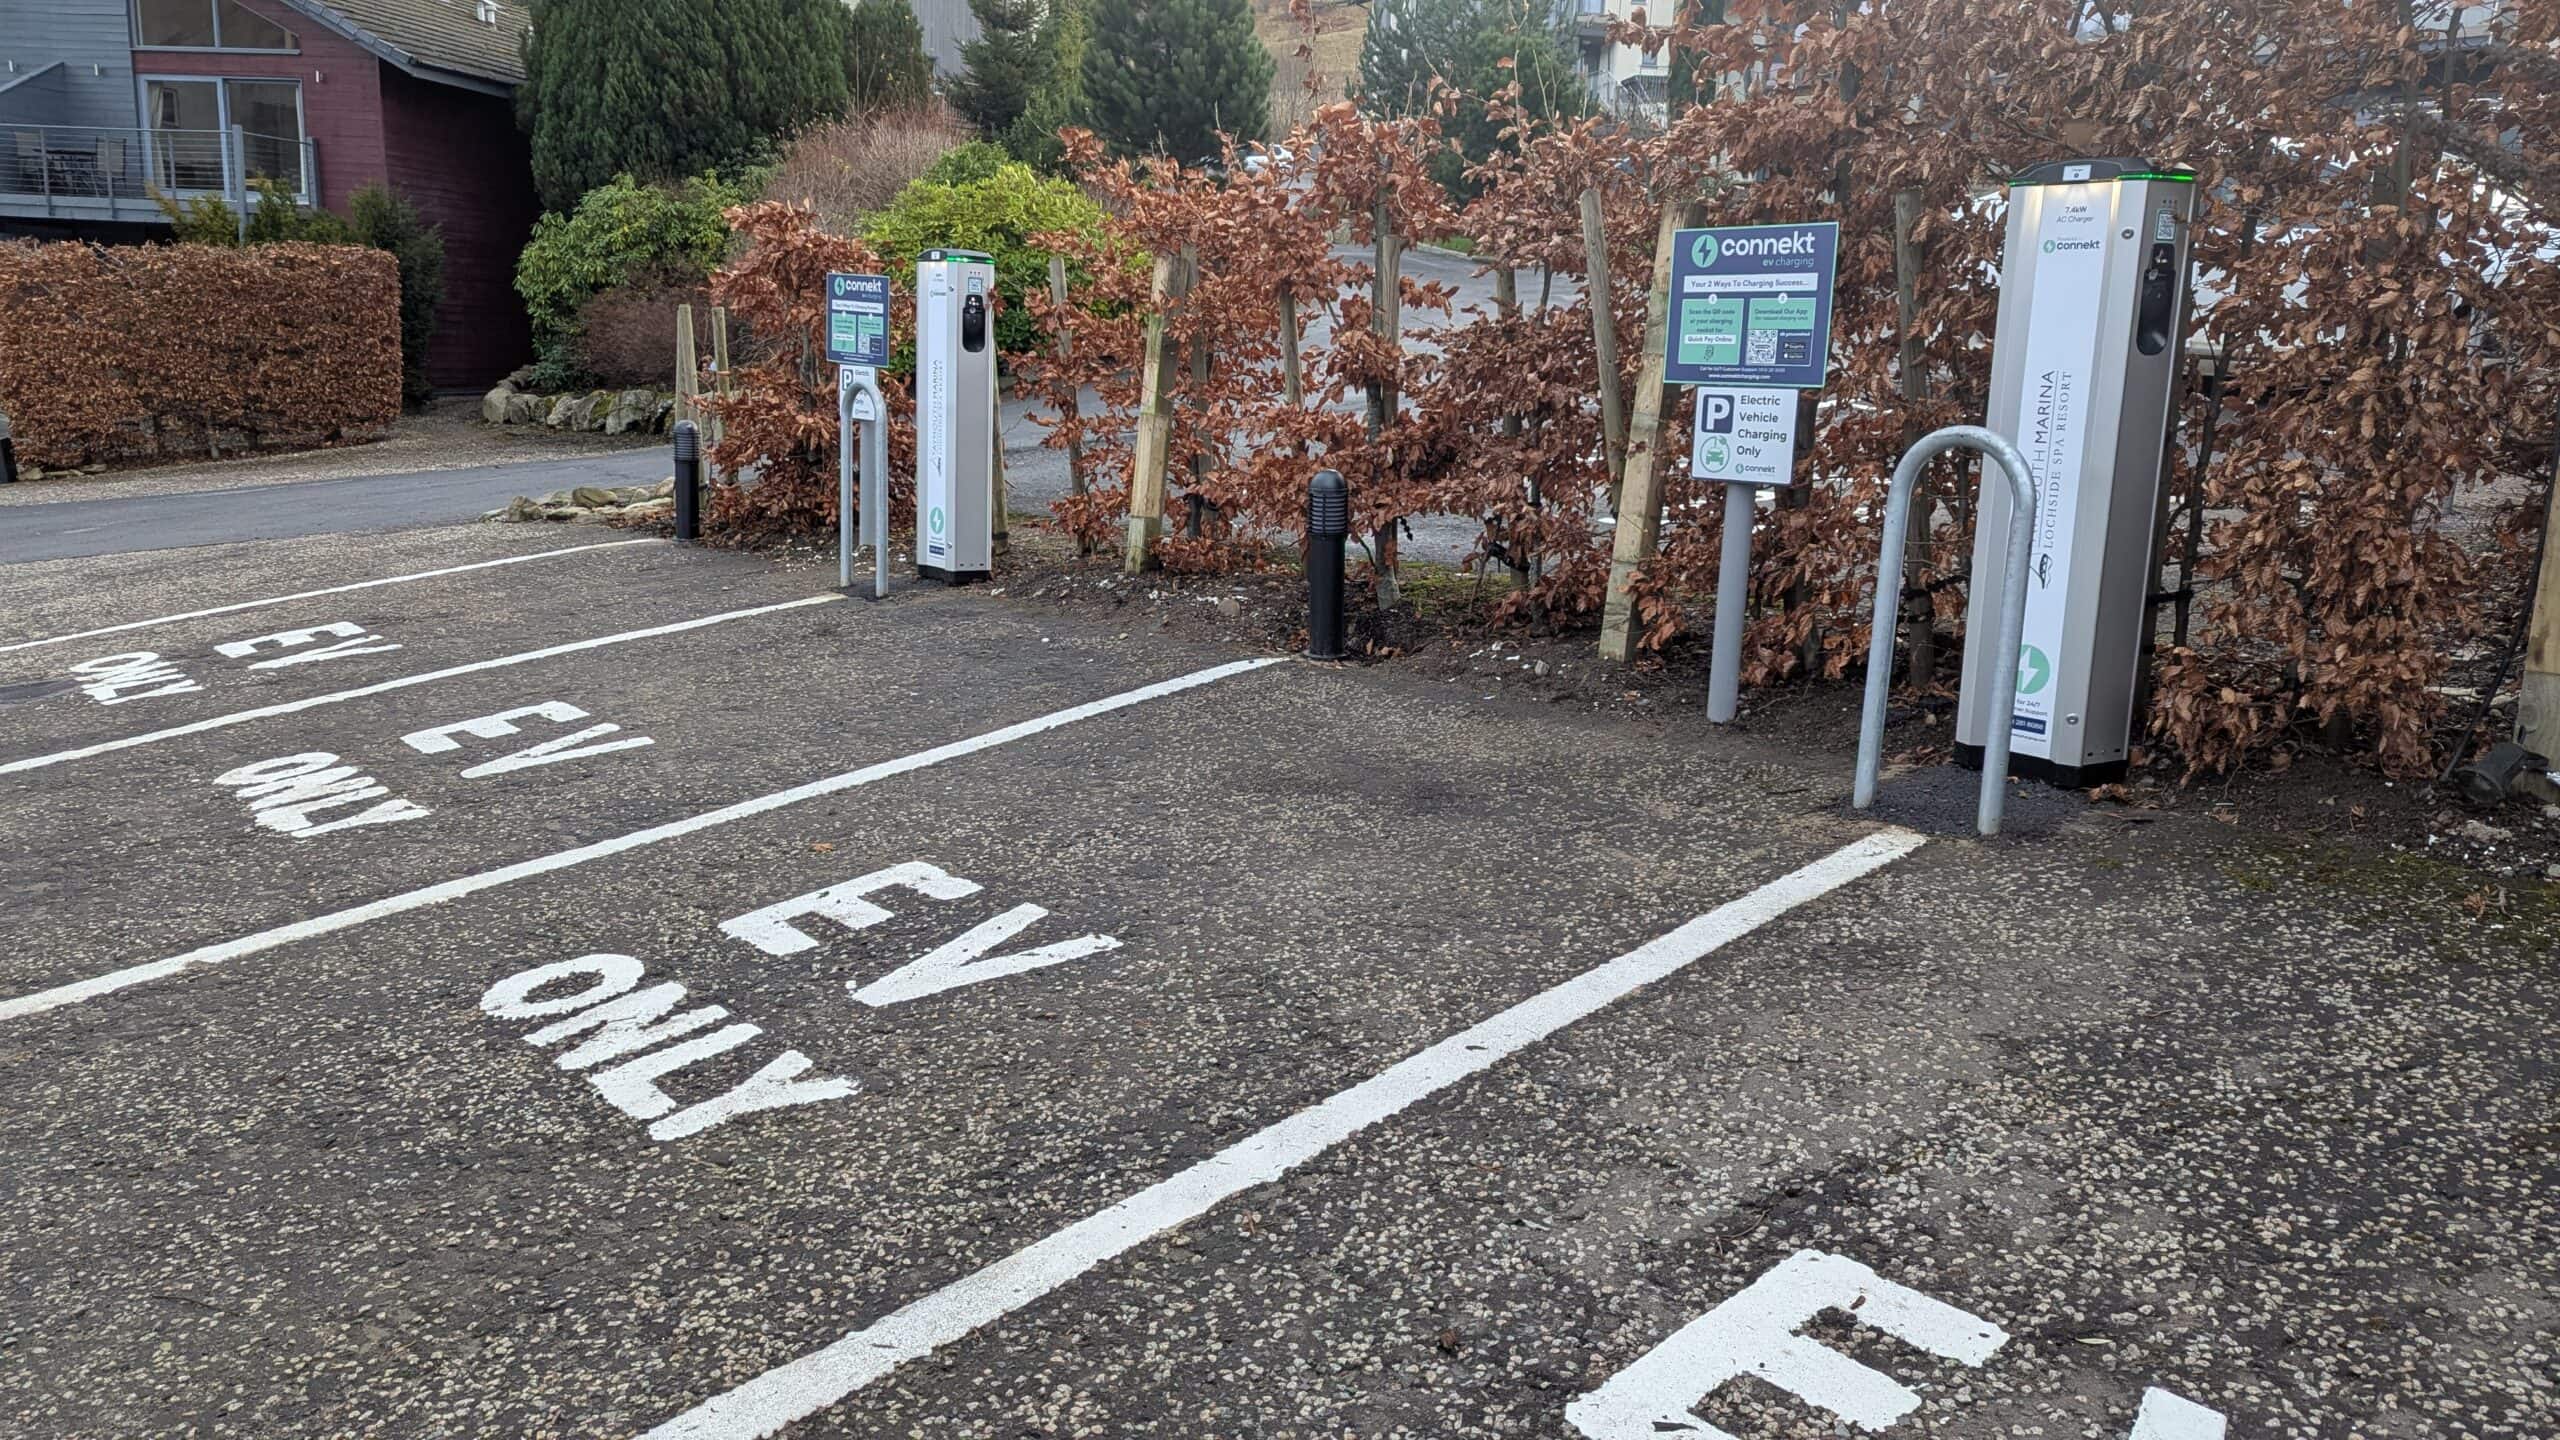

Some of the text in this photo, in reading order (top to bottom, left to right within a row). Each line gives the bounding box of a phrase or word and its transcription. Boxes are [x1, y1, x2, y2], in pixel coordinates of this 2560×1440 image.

[1721, 231, 1816, 256] connekt
[2056, 240, 2100, 250] connekt
[1762, 256, 1814, 268] ev charging
[846, 279, 882, 293] connekt
[1708, 280, 1713, 288] 2
[1713, 280, 1731, 289] Ways
[1742, 279, 1774, 289] Charging
[1796, 308, 1808, 316] App
[843, 370, 853, 390] P
[1740, 394, 1781, 406] Electric
[2035, 370, 2055, 444] MARINA
[1706, 397, 1730, 431] P
[1739, 411, 1779, 423] Vehicle
[1737, 428, 1787, 443] Charging
[1736, 445, 1761, 458] Only
[2043, 371, 2072, 549] LOCHSIDE SPA RESORT
[1744, 464, 1776, 473] connekt
[213, 621, 403, 670] EV
[70, 651, 204, 706] ONLY
[400, 700, 655, 779] EV
[213, 751, 431, 838] ONLY
[718, 861, 1124, 1007] EV
[480, 953, 862, 1141] ONLY
